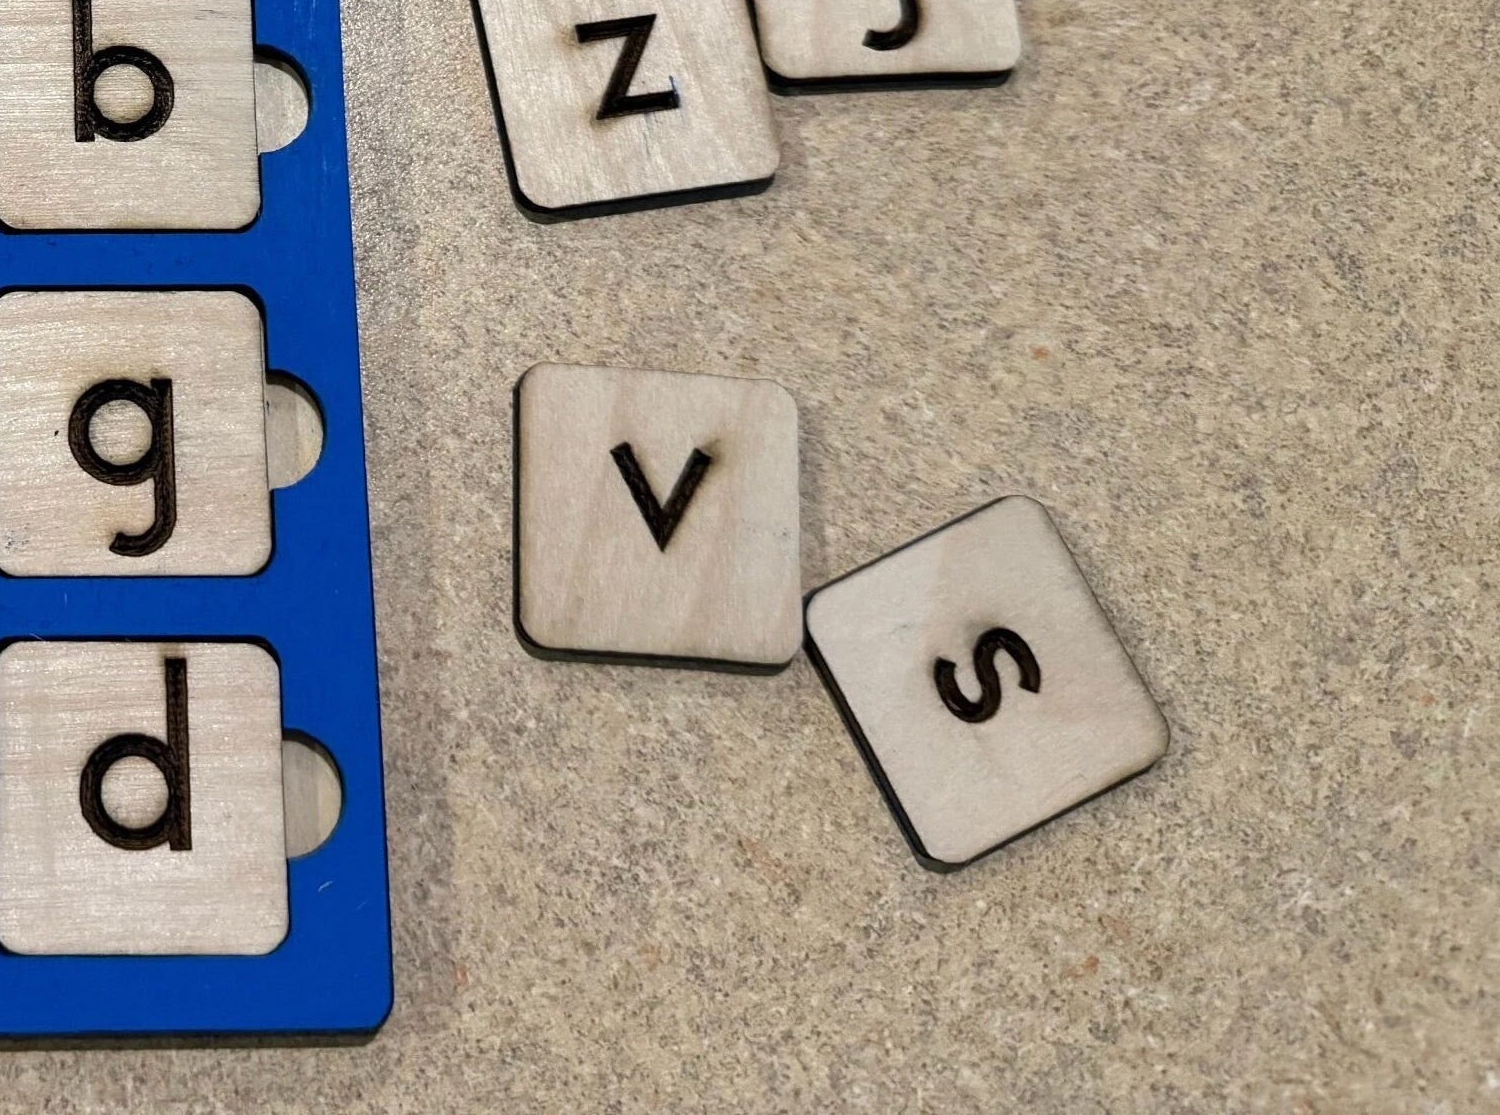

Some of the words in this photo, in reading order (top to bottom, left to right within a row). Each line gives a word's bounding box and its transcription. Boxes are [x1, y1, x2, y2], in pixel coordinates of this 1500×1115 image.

[575, 14, 679, 121] z
[68, 377, 177, 557] g
[610, 442, 715, 552] v
[933, 627, 1041, 723] s
[80, 656, 192, 851] d
